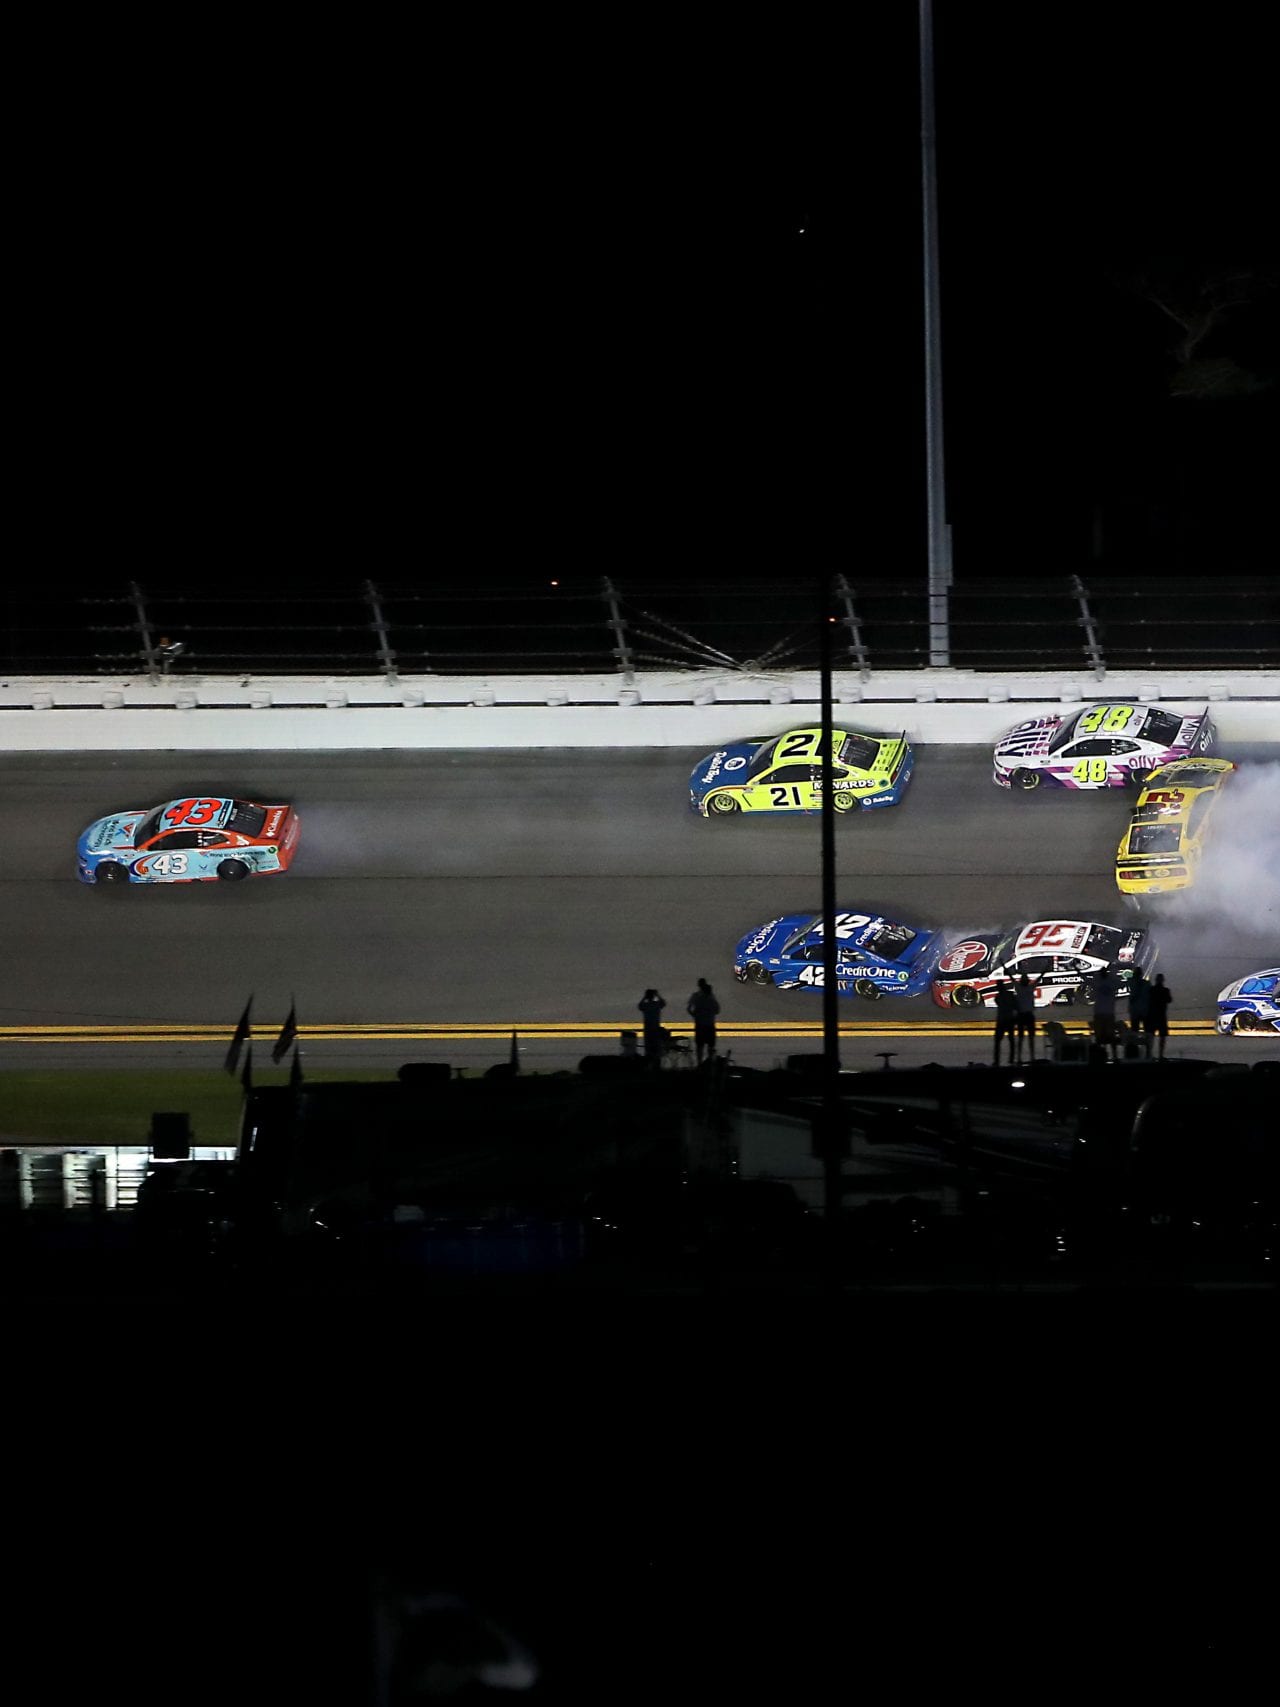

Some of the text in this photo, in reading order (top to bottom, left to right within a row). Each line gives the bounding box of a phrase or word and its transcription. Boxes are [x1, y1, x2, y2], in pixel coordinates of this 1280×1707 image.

[1081, 705, 1135, 733] 48
[1181, 719, 1199, 743] ally
[1073, 759, 1107, 783] 48
[1128, 756, 1157, 770] ally
[812, 778, 875, 792] MNARDS
[770, 786, 801, 807] 21
[165, 798, 223, 826] 43
[267, 810, 283, 831] Columbia
[152, 852, 189, 876] 43
[835, 963, 898, 979] CreditOne
